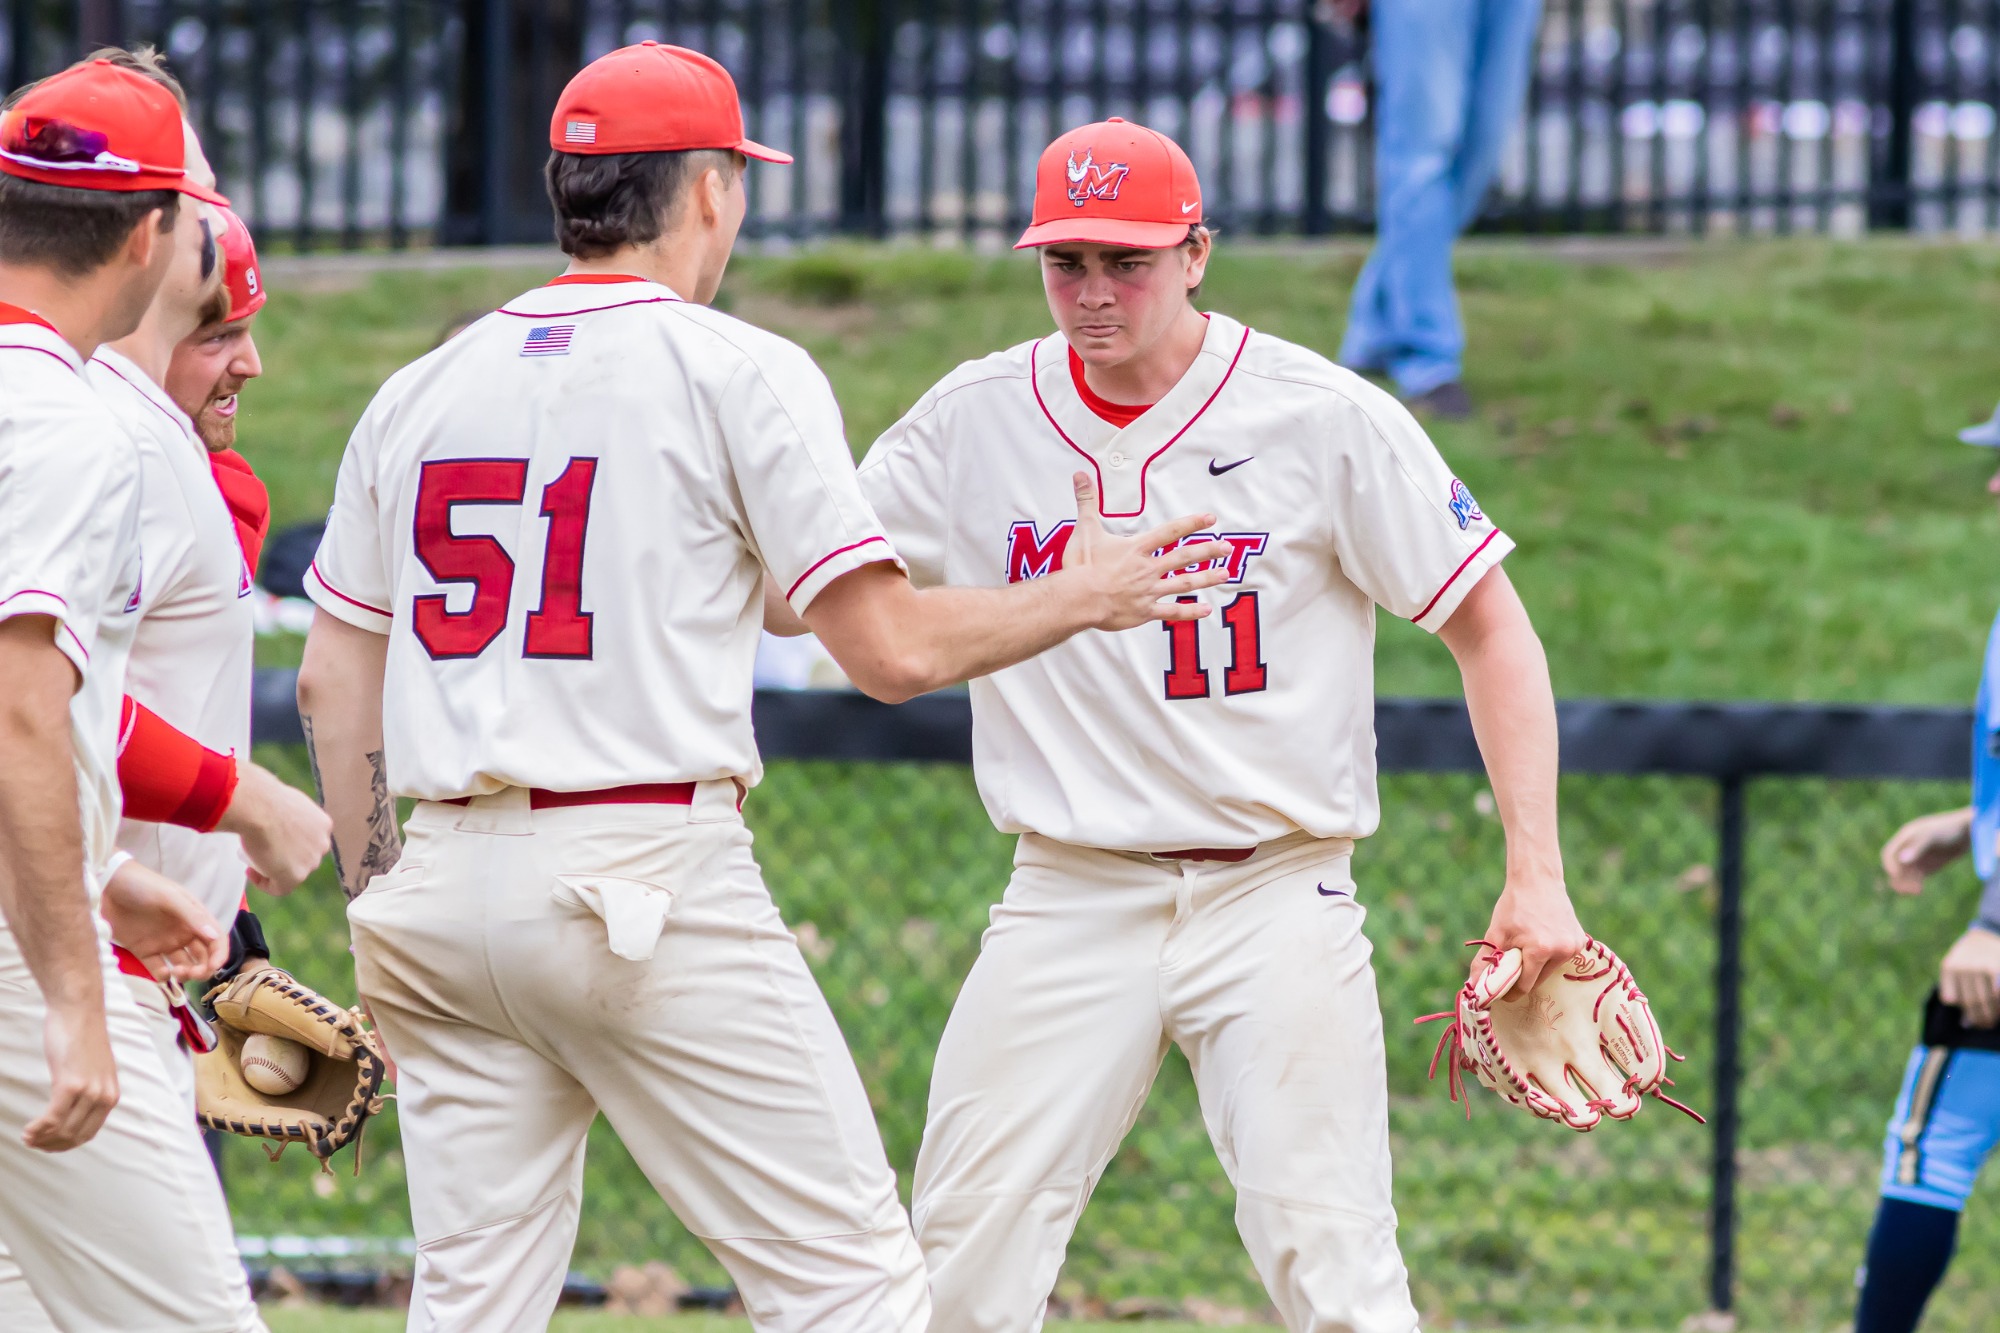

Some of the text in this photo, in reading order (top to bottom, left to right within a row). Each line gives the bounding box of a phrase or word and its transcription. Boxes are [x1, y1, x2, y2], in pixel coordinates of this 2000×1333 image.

[245, 266, 258, 296] 9
[412, 456, 599, 661] 51
[1162, 591, 1268, 701] 11
